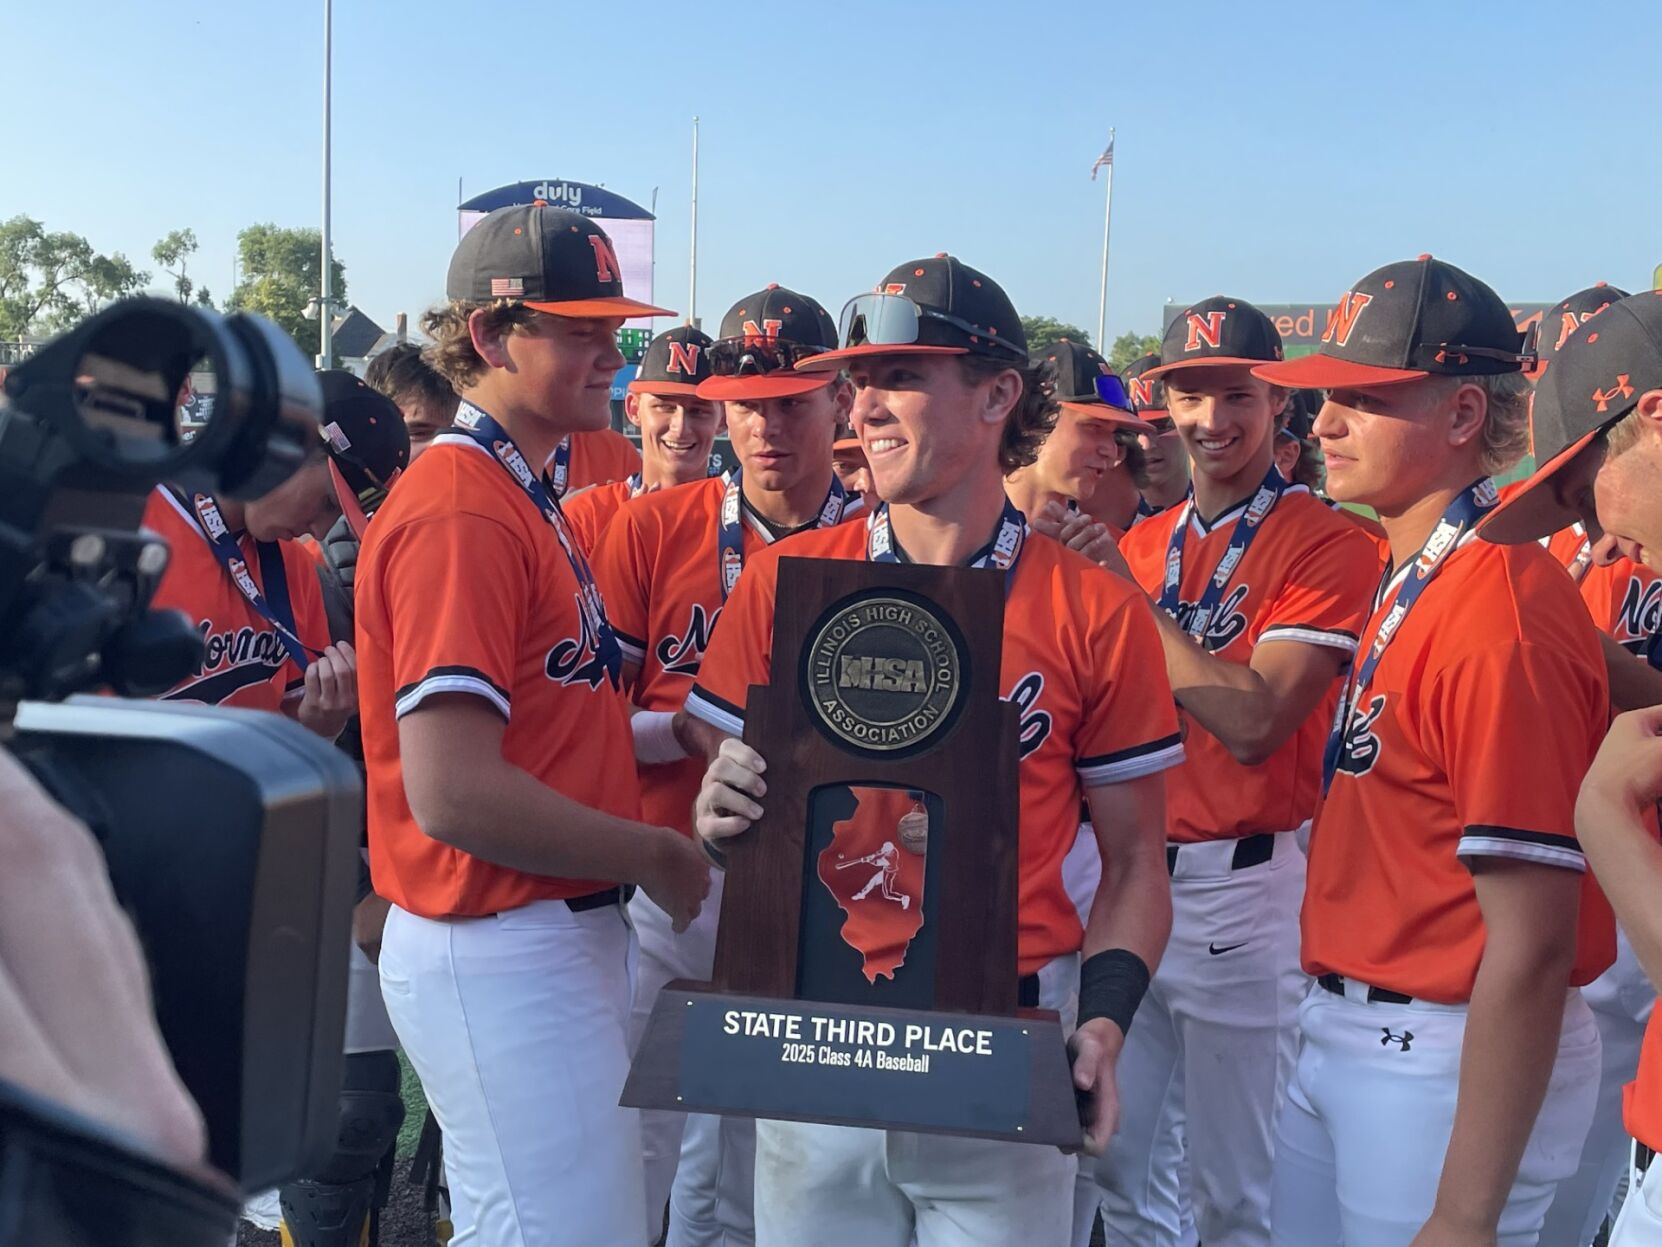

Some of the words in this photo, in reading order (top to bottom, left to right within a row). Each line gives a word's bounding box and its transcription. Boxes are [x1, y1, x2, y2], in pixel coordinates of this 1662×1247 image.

[533, 182, 582, 205] duly
[1185, 311, 1226, 352] N
[1321, 291, 1373, 347] N
[666, 342, 701, 376] N
[1129, 377, 1155, 406] N
[816, 613, 861, 684] ILLINOIS
[866, 606, 912, 625] HIGH
[915, 619, 952, 693] SCHOOL
[823, 699, 940, 743] ASSOCIATION
[723, 1010, 803, 1040] STATE
[811, 1017, 895, 1047] THIRD
[905, 1025, 993, 1056] PLACE
[781, 1043, 816, 1065] 2025
[818, 1045, 851, 1067] Class
[854, 1049, 873, 1069] 4A
[876, 1051, 930, 1073] Baseball
